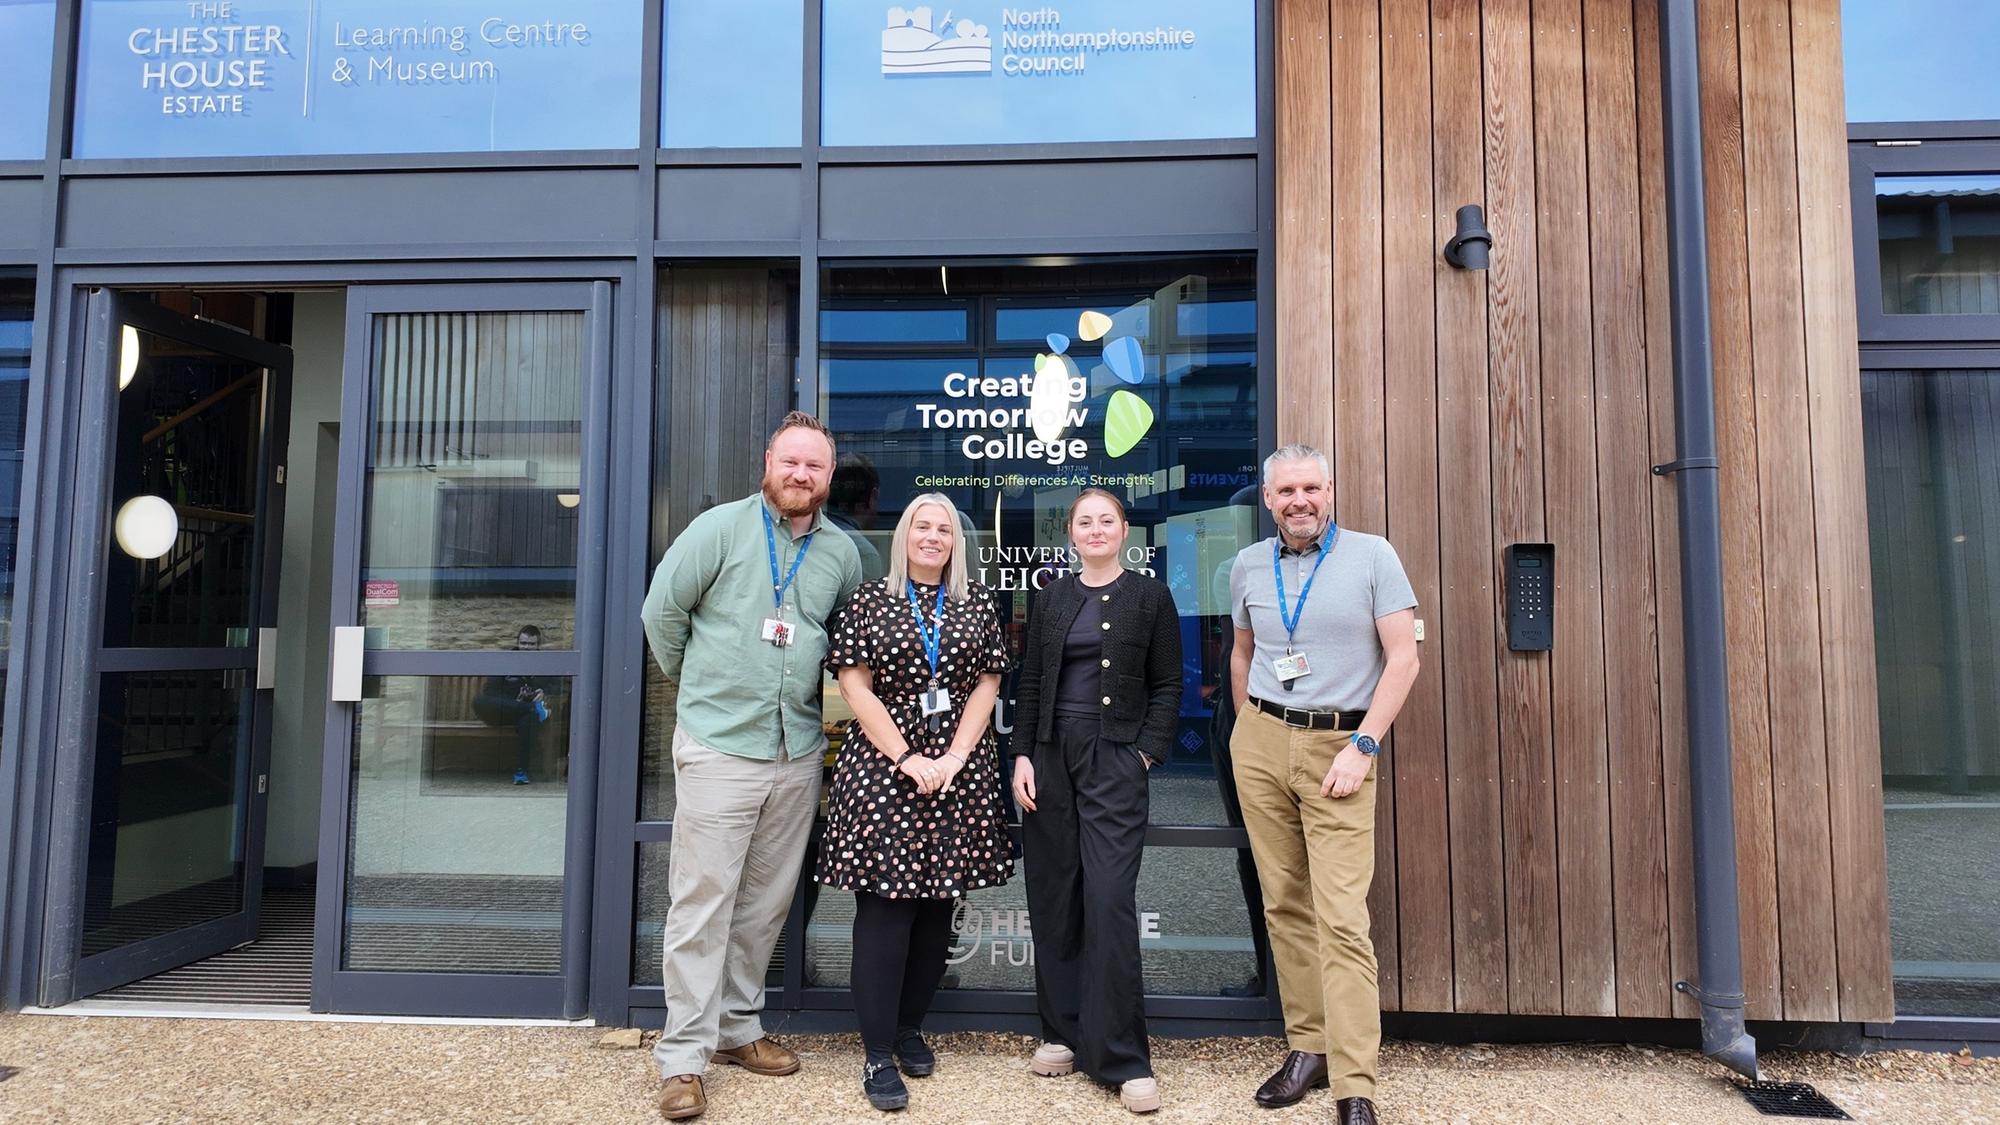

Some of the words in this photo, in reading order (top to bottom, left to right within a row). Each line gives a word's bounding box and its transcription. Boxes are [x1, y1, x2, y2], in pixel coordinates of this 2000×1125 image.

[189, 1, 231, 18] THE
[1002, 8, 1060, 27] North
[128, 25, 288, 55] CHESTER
[334, 19, 465, 52] Learning
[480, 17, 587, 45] Centre
[1002, 26, 1195, 49] Northamptonshire
[332, 57, 353, 82] &
[368, 55, 496, 81] Museum
[1002, 53, 1085, 73] Council
[142, 60, 266, 89] HOUSE
[162, 95, 243, 114] ESTATE
[962, 433, 1088, 464] College
[915, 475, 990, 488] Celebrating
[994, 474, 1067, 487] Differences
[1070, 474, 1087, 487] As
[1089, 474, 1155, 489] Strengths
[978, 546, 1078, 563] UNIVERS
[1126, 546, 1156, 563] OF
[366, 588, 398, 596] DualCom
